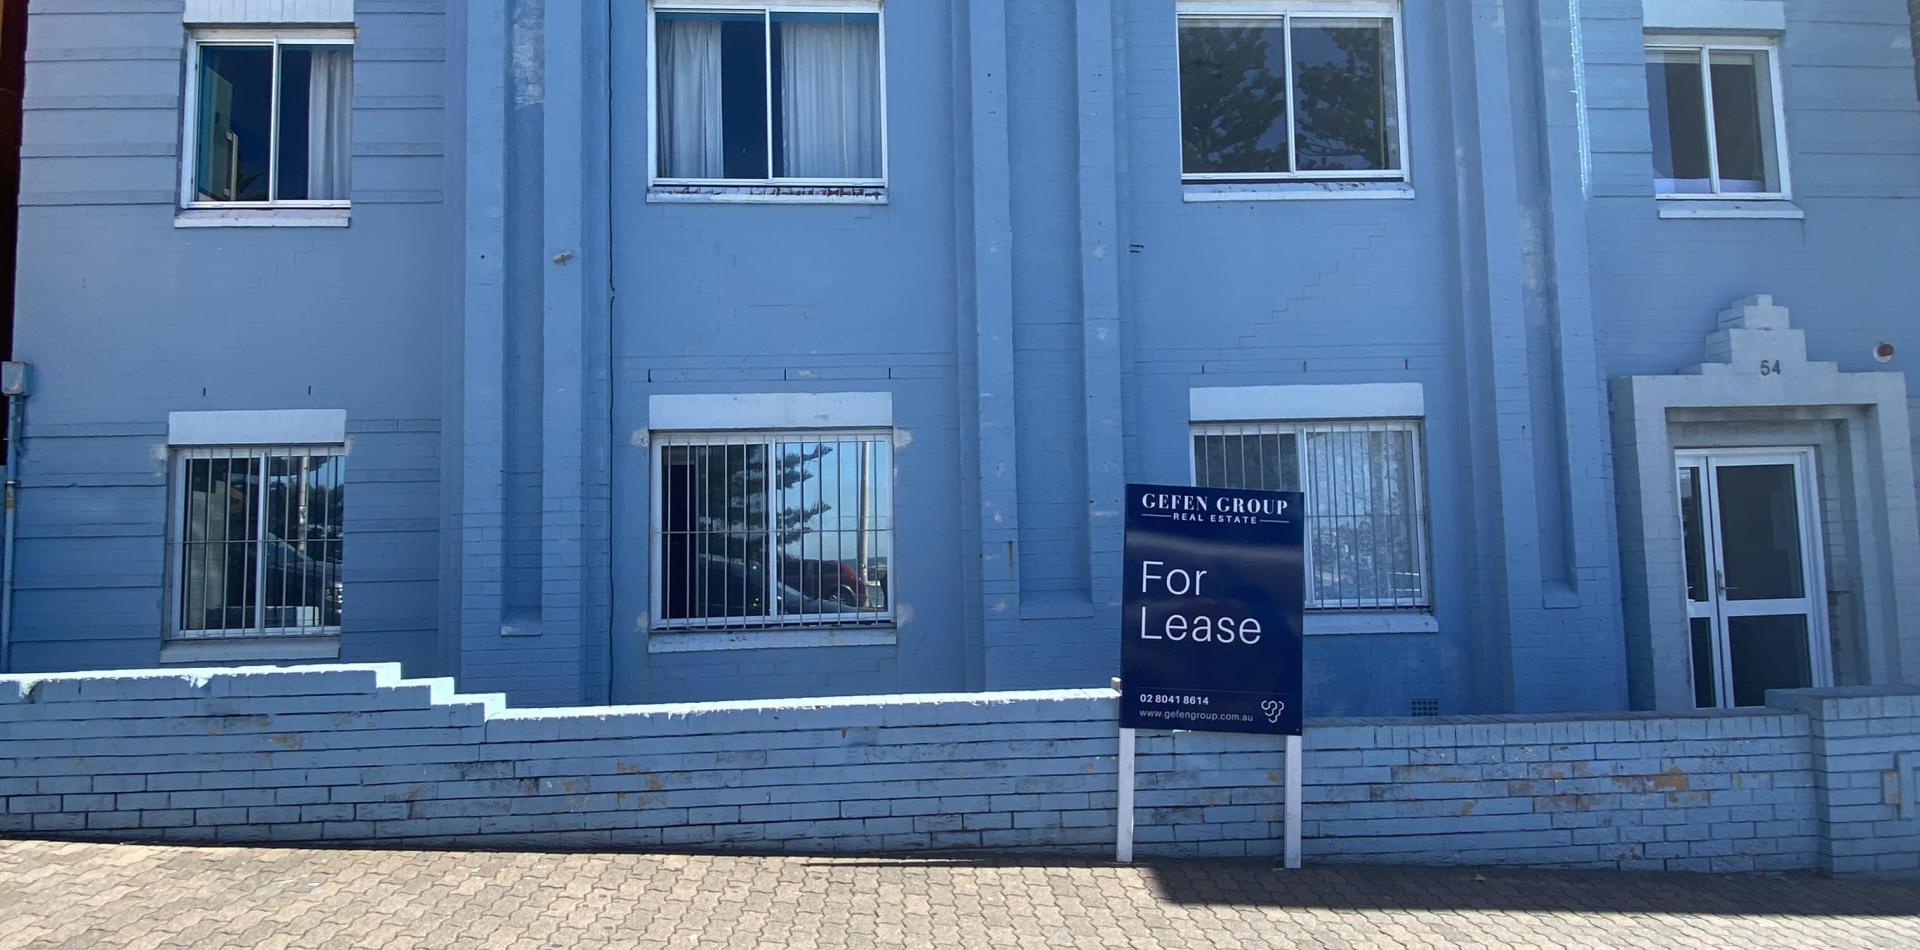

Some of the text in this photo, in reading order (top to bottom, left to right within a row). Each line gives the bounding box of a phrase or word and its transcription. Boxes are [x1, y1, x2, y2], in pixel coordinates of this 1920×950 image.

[1141, 493, 1288, 515] GEFEN GROUP
[1173, 513, 1257, 525] REAL ESTATE
[1142, 561, 1207, 595] For
[1141, 606, 1261, 644] Lease
[1140, 694, 1209, 705] 02 8041 8614
[1139, 709, 1254, 722] www.gefengroup.com.au
